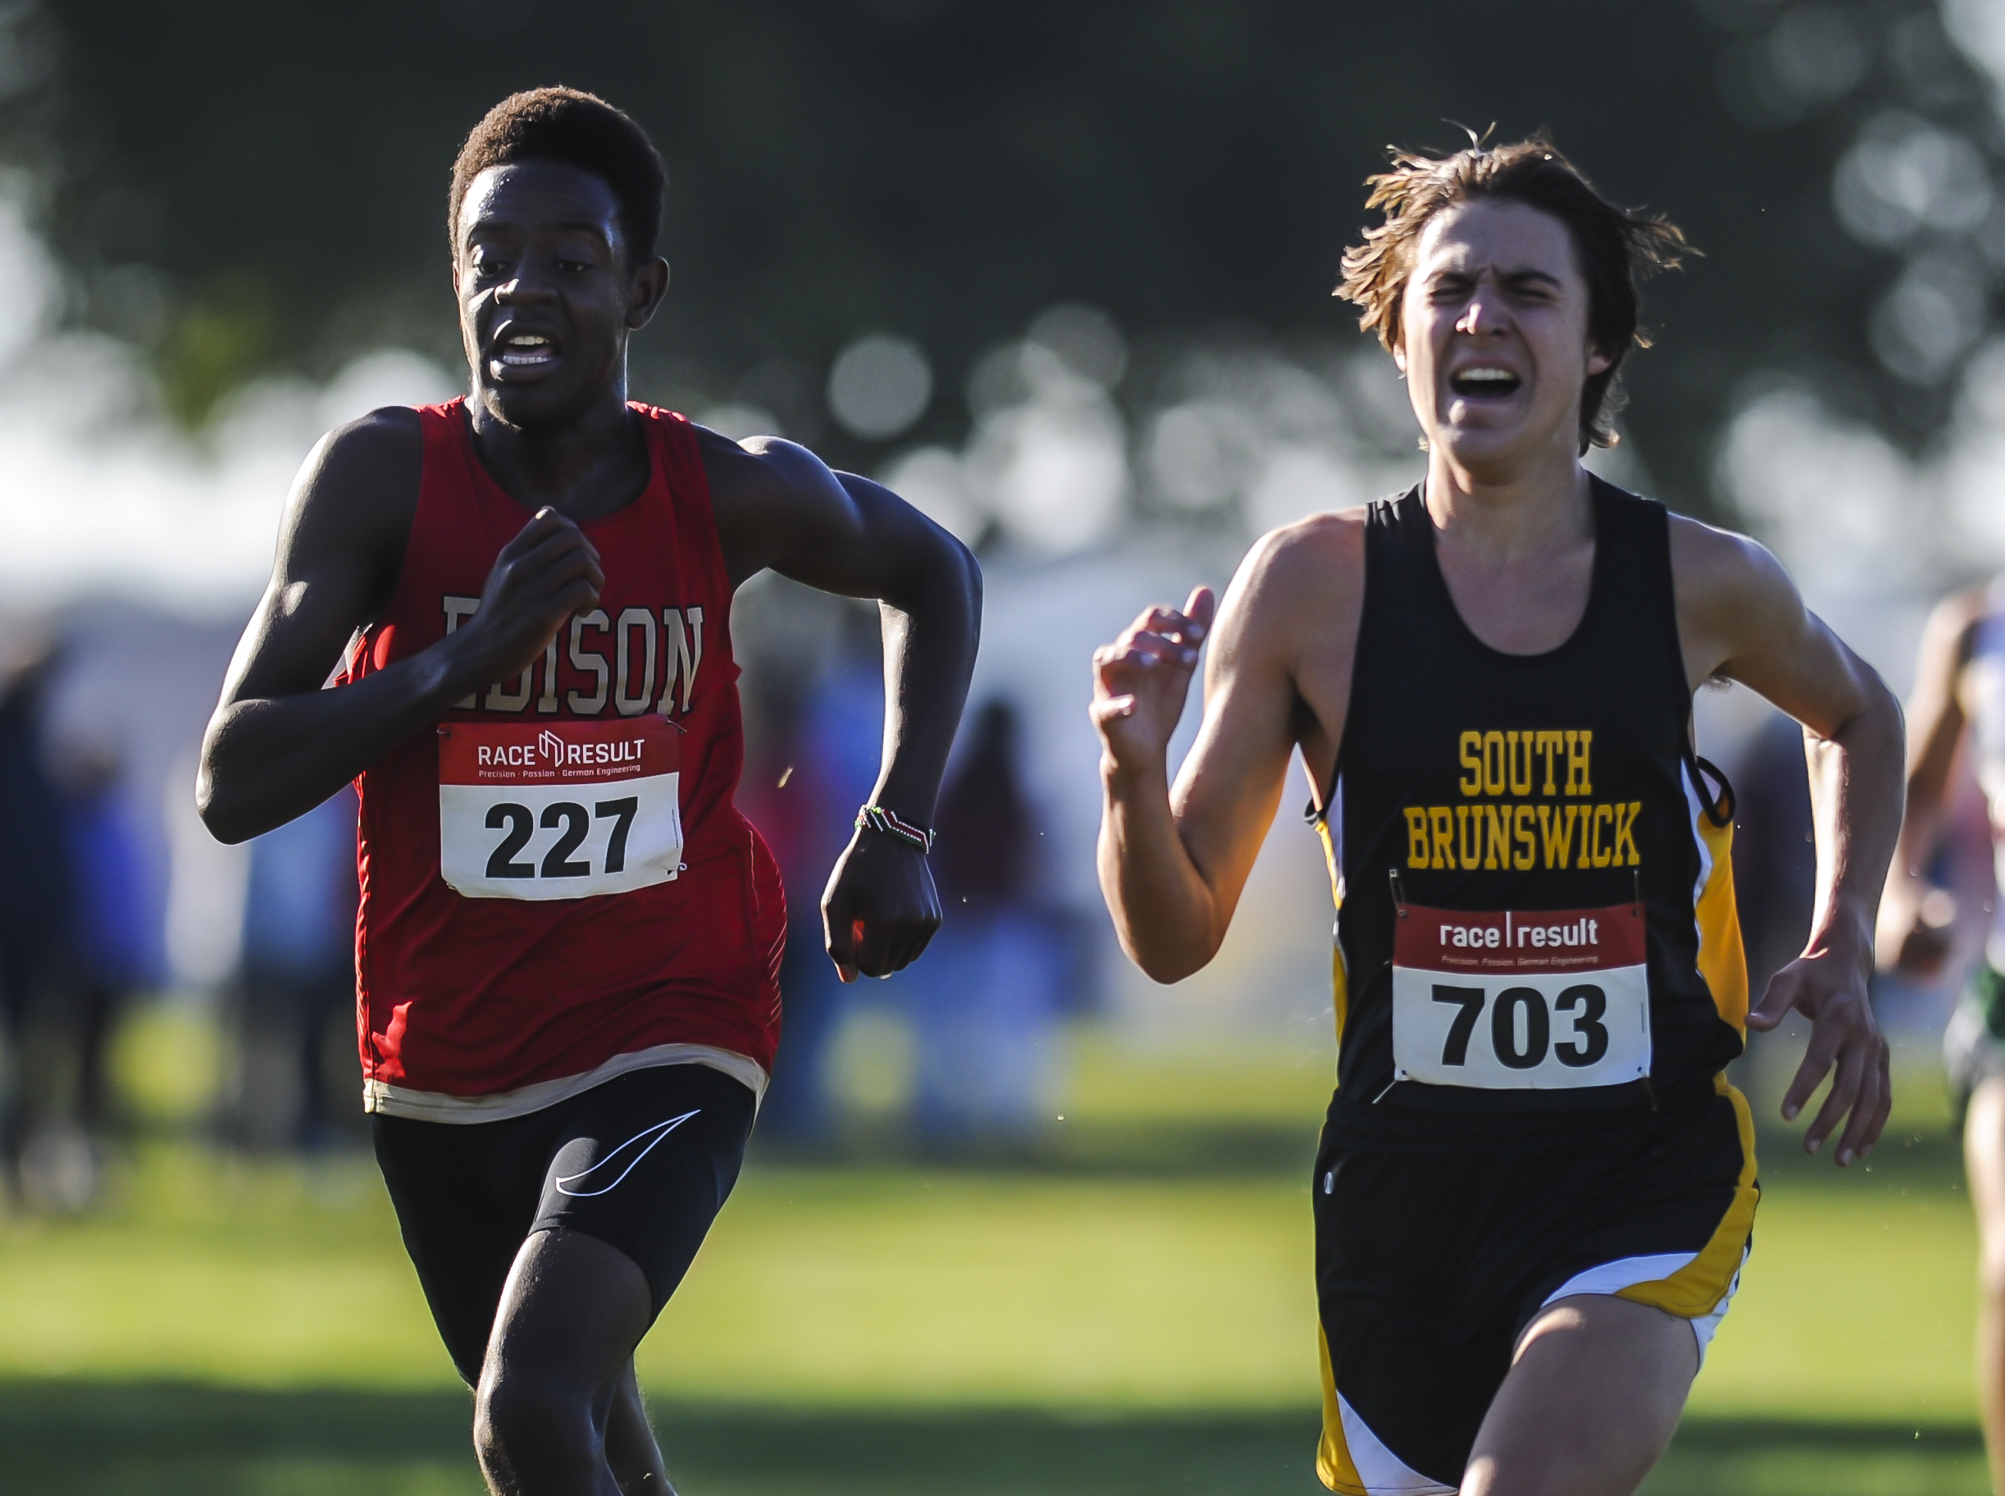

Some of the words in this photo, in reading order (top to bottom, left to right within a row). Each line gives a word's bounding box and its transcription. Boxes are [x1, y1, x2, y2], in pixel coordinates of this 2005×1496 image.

[477, 745, 536, 766] RACE
[567, 738, 645, 764] RESULT
[478, 769, 516, 778] Precision
[522, 768, 556, 778] Passion
[562, 769, 595, 777] German
[596, 764, 641, 776] Engineering
[1459, 730, 1593, 796] SOUTH
[484, 796, 639, 879] 227
[1403, 801, 1641, 870] BRUNSWICK
[1431, 983, 1609, 1070] 703
